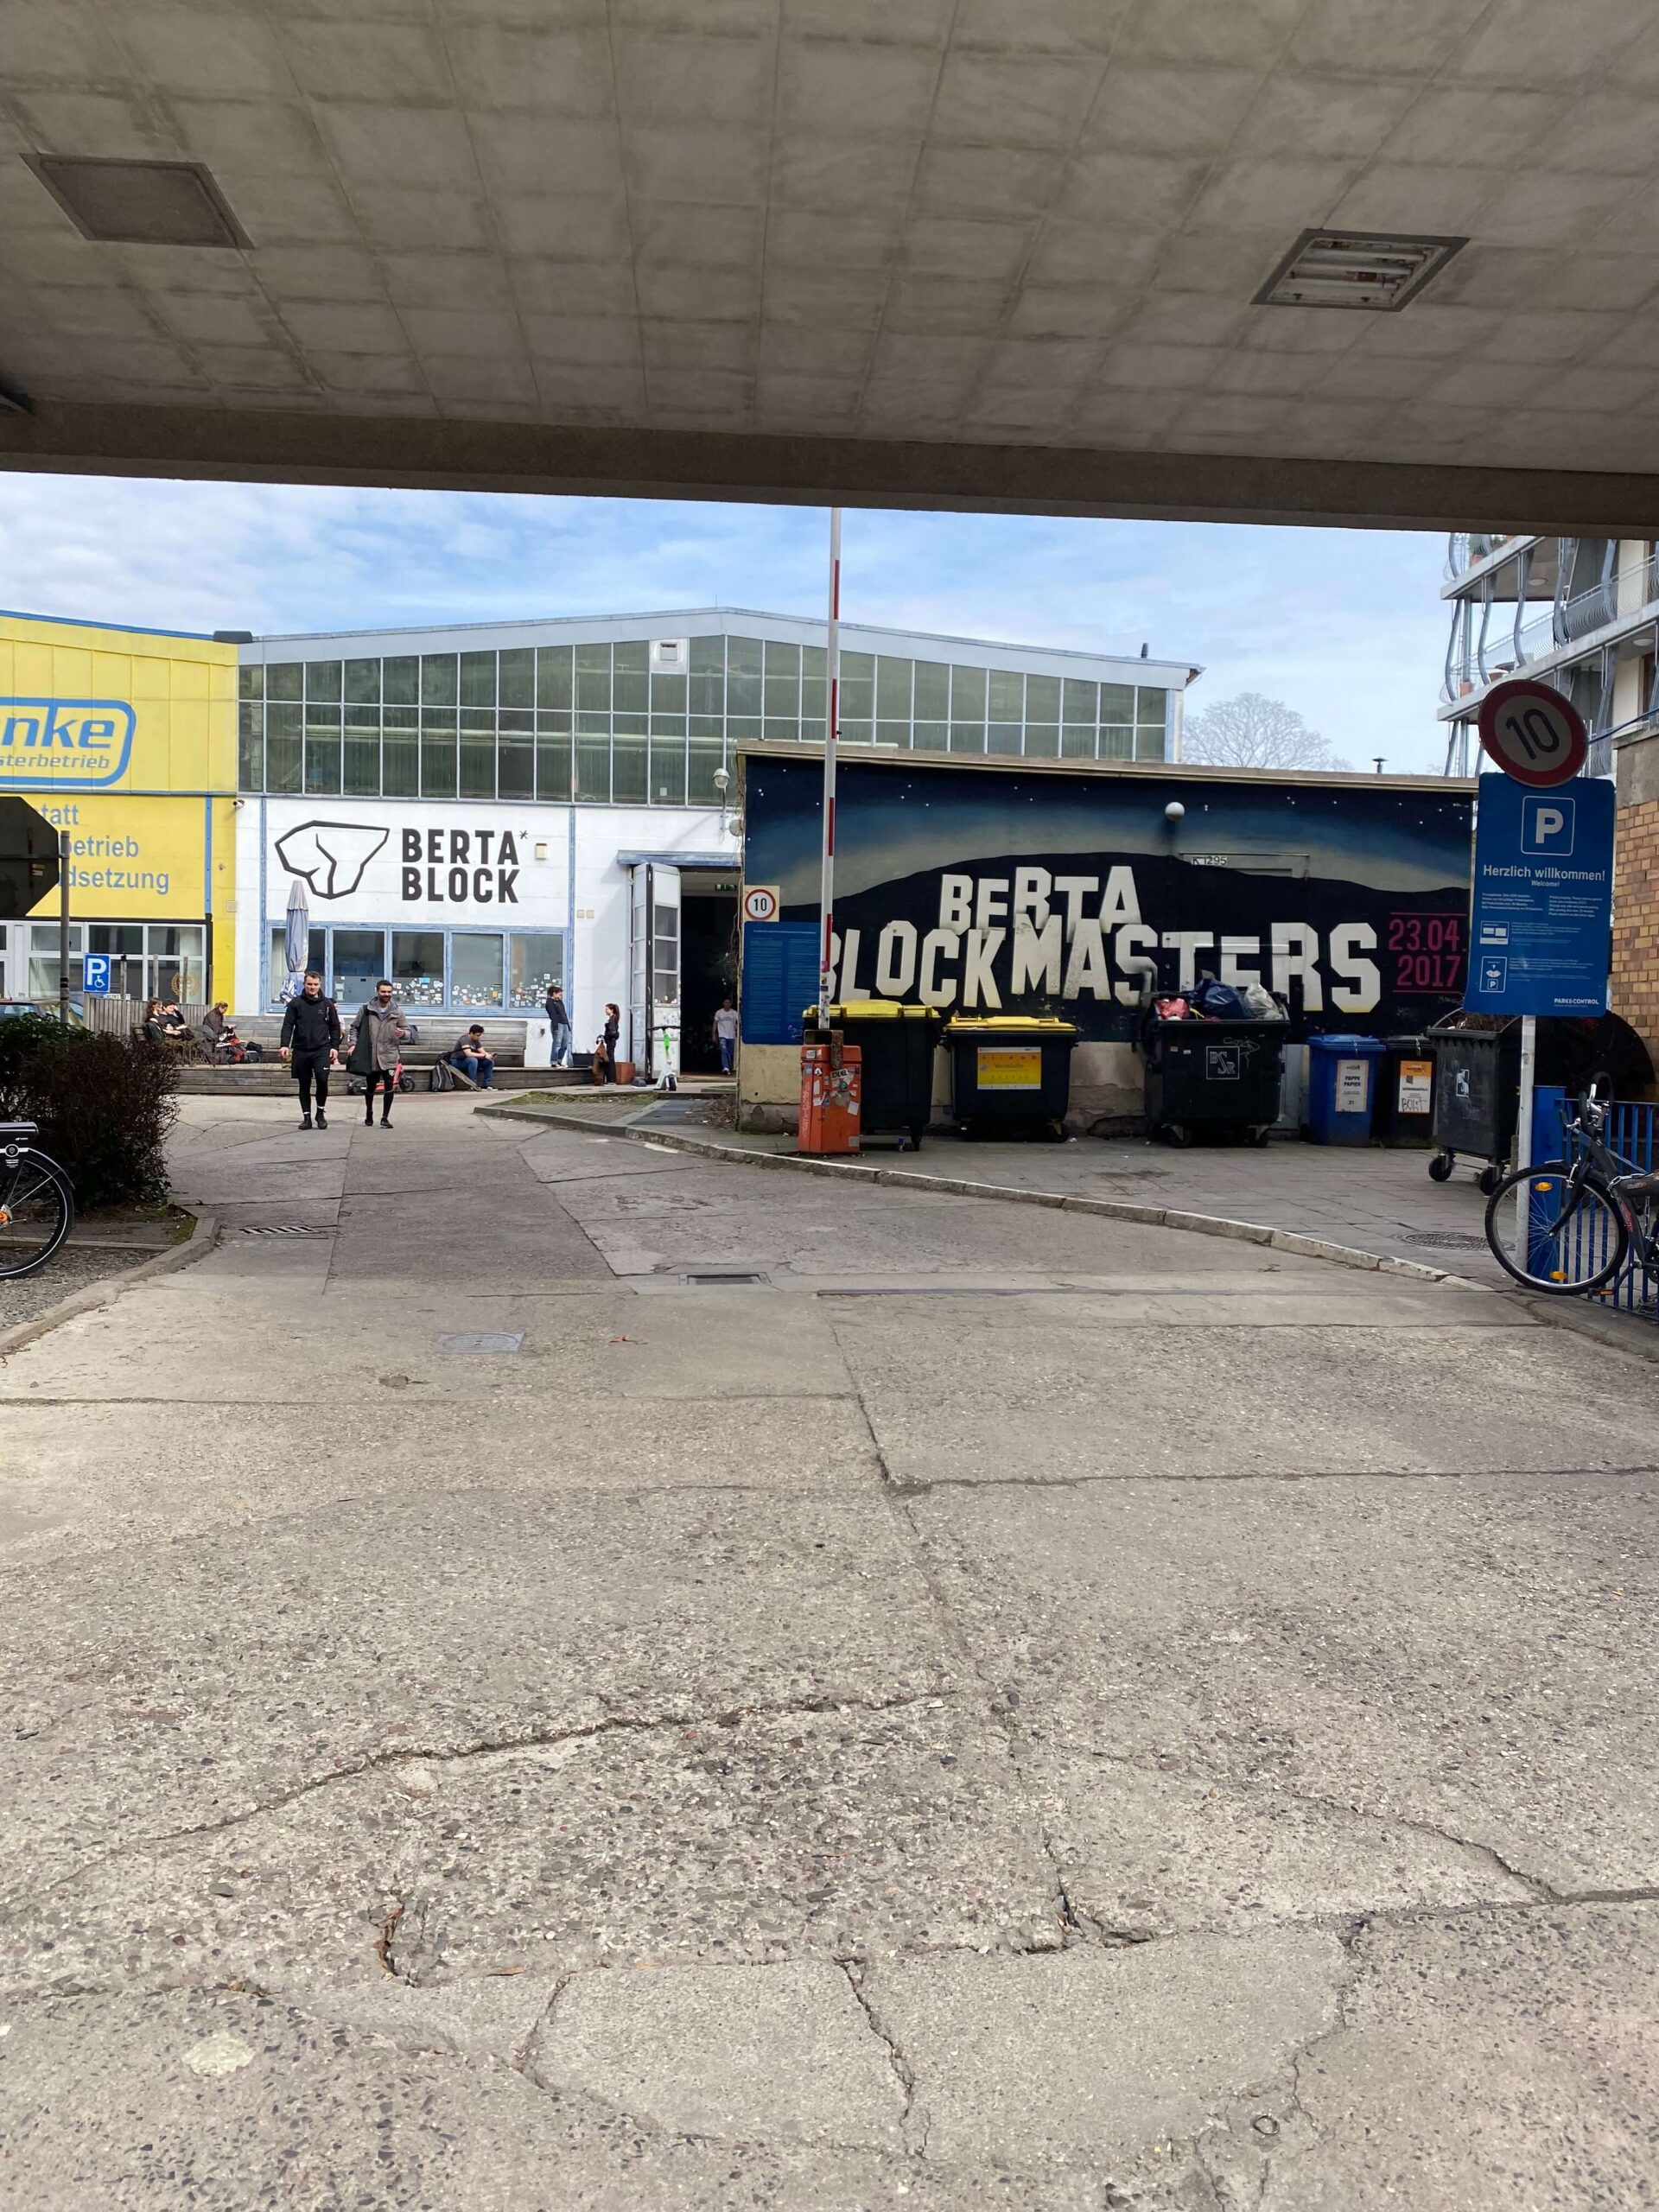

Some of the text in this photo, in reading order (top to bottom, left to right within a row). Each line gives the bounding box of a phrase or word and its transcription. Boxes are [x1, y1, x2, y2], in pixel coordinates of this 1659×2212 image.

[1506, 709, 1560, 760] 10
[35, 803, 79, 825] tatt
[1535, 808, 1564, 843] P
[65, 836, 138, 857] etrieb
[402, 828, 518, 865] BERTA
[402, 867, 519, 903] BLOCK
[1483, 864, 1605, 880] Herzlich willkommen!
[753, 898, 767, 912] 10
[939, 866, 1142, 943] BERTA
[1389, 918, 1466, 951] 23.04.
[87, 958, 106, 985] P
[1397, 955, 1461, 987] 2017
